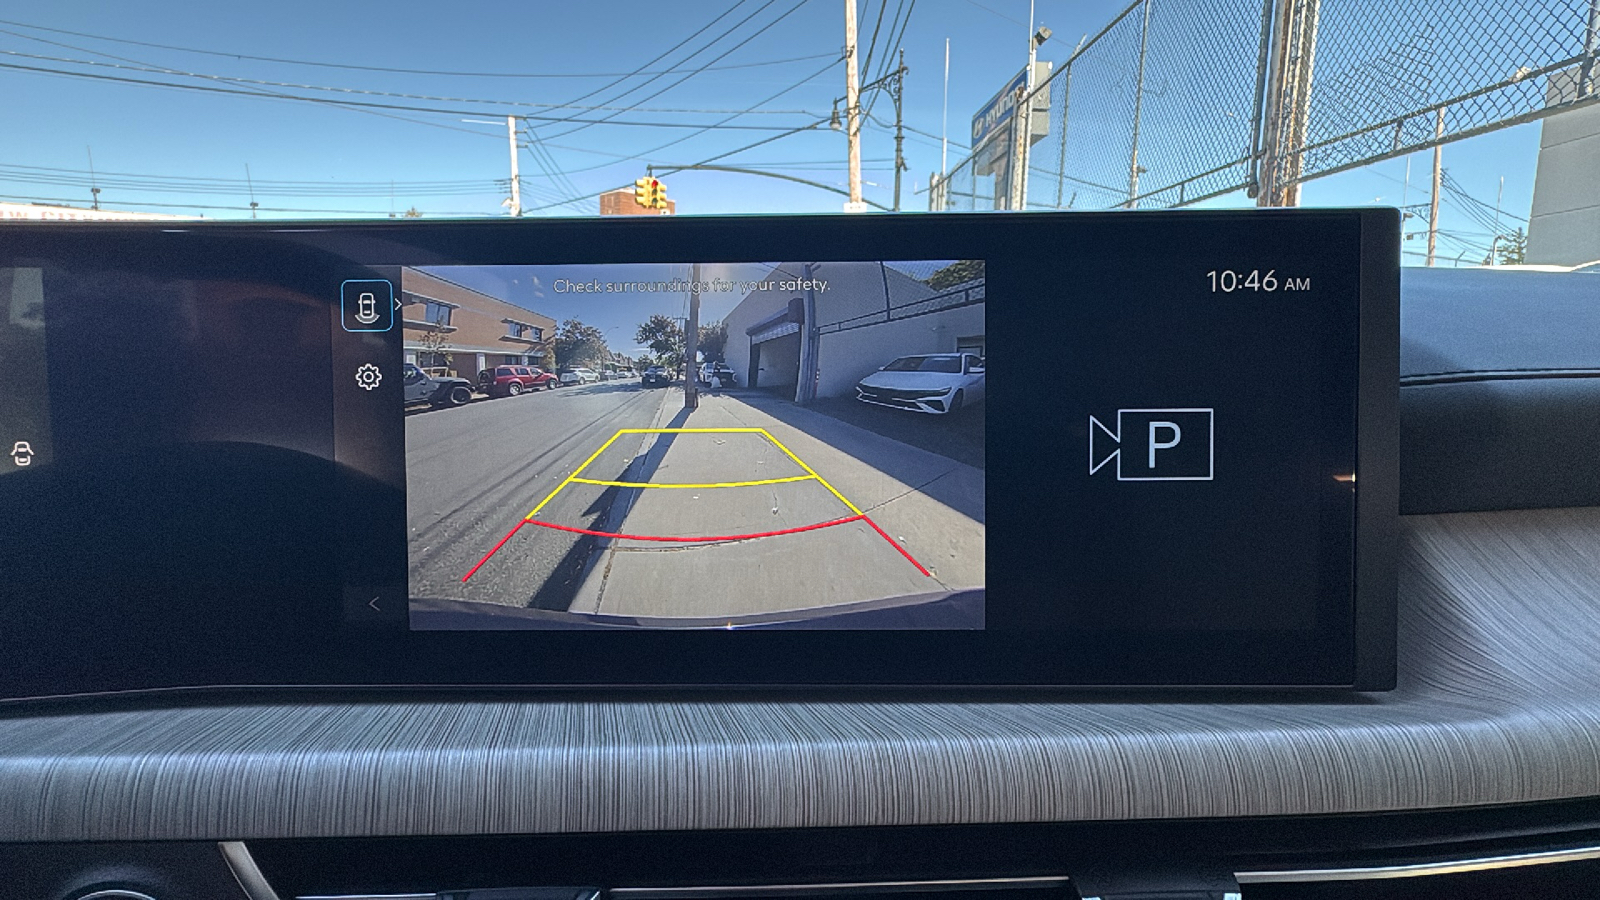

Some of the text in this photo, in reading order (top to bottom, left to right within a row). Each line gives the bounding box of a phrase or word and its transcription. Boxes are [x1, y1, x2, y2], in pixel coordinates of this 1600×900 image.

[985, 82, 1025, 128] HYUND
[553, 276, 831, 296] Check surroundings for your safety.
[1206, 269, 1311, 293] 10:46 AM
[1148, 421, 1182, 469] P
